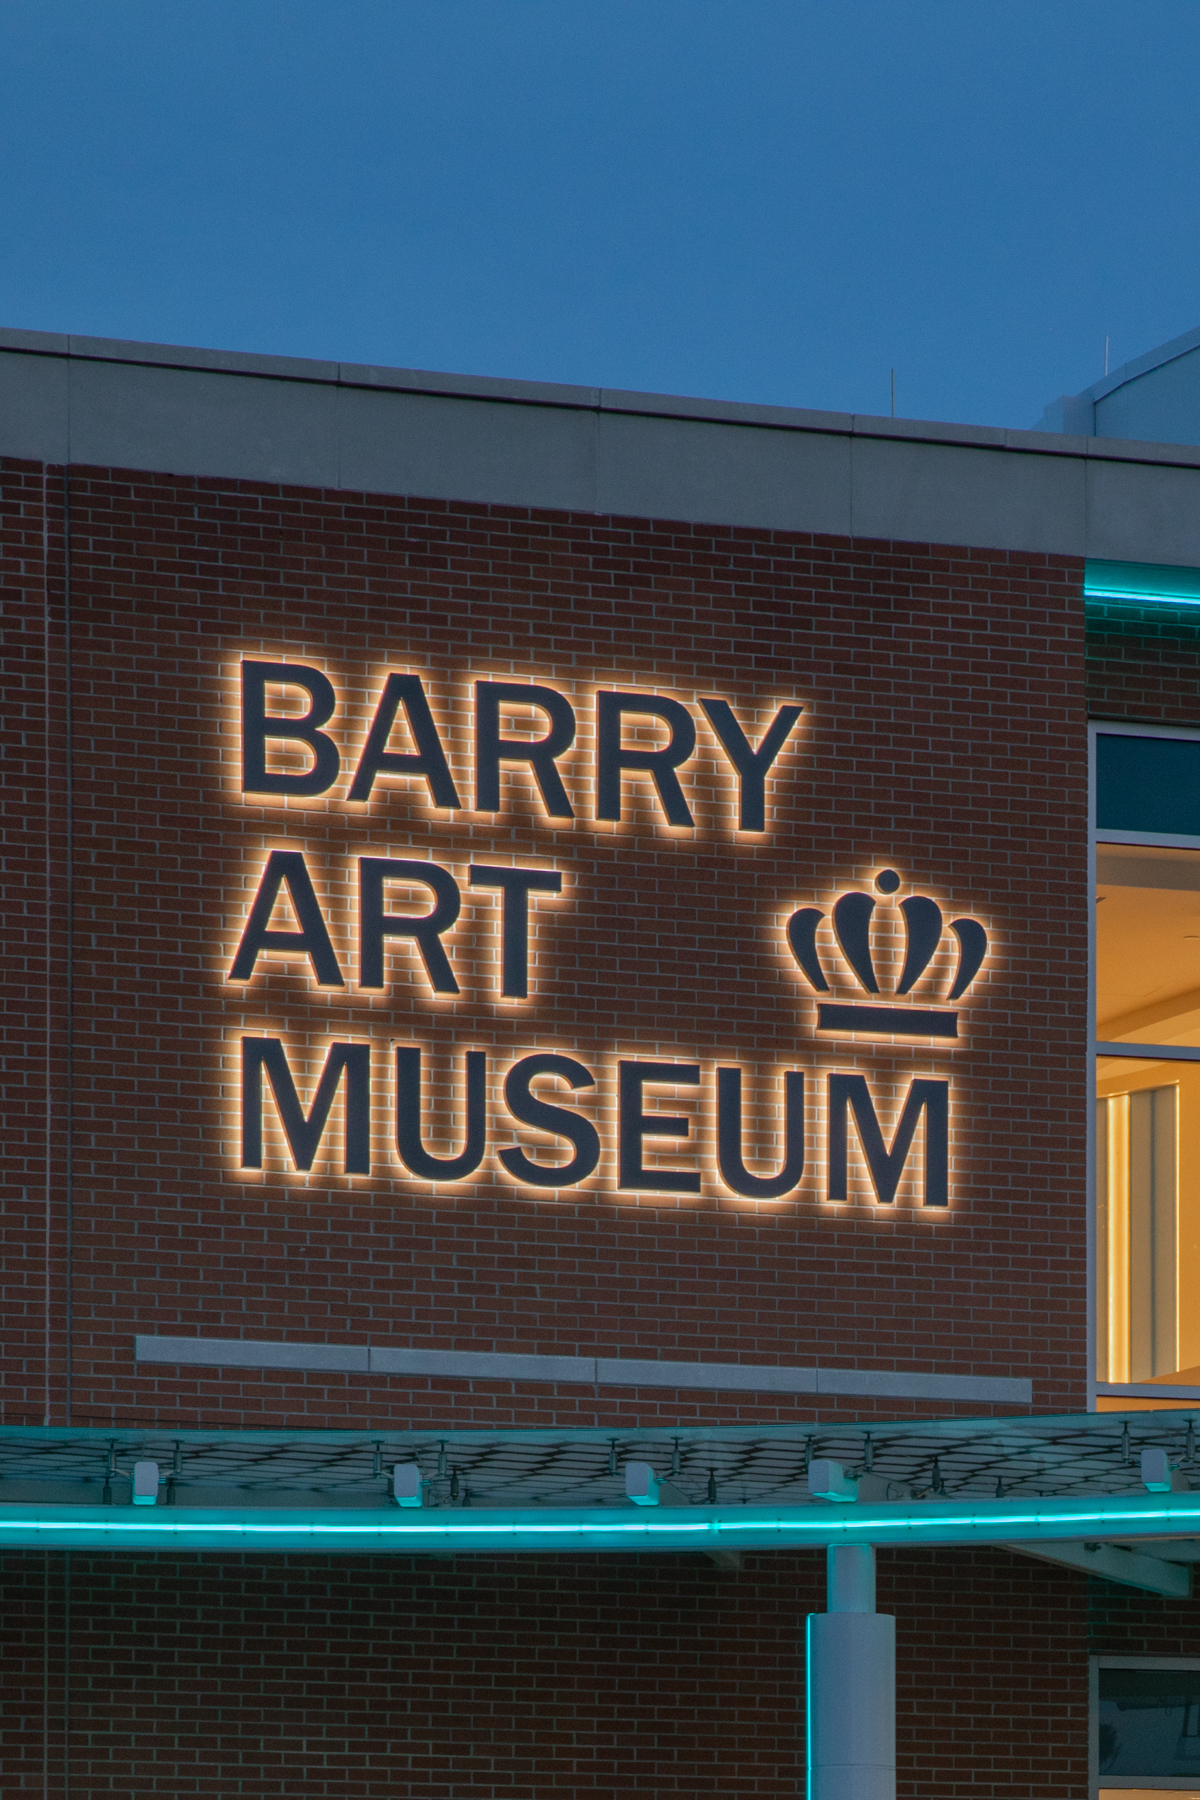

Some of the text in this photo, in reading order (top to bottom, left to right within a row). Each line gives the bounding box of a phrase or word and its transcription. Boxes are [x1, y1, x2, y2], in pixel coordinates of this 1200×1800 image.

[241, 659, 804, 832] BARRY
[228, 850, 562, 999] ART
[240, 1036, 949, 1207] MUSEUM
